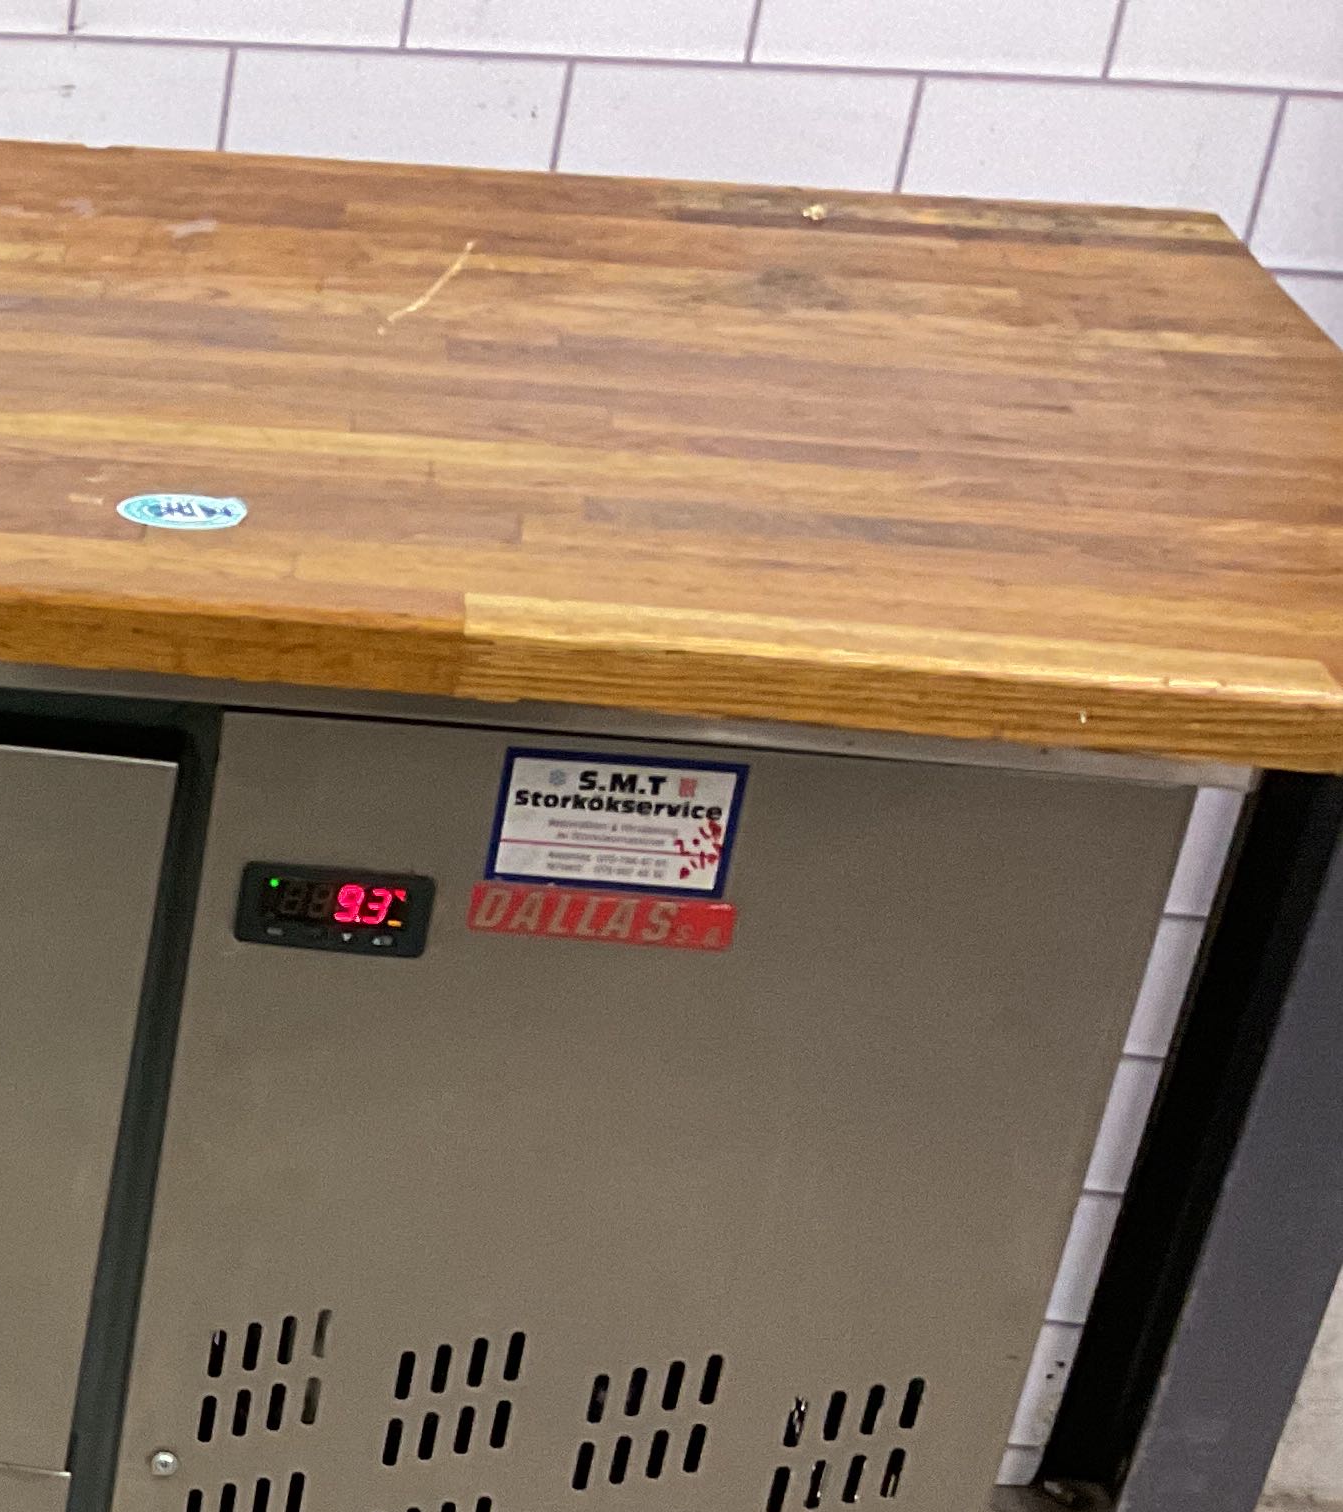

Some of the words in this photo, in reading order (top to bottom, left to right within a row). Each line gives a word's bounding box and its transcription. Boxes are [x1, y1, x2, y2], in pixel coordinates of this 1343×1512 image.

[578, 769, 667, 796] S.M.T
[514, 789, 723, 822] Storkökservice
[473, 886, 679, 942] DALLAS
